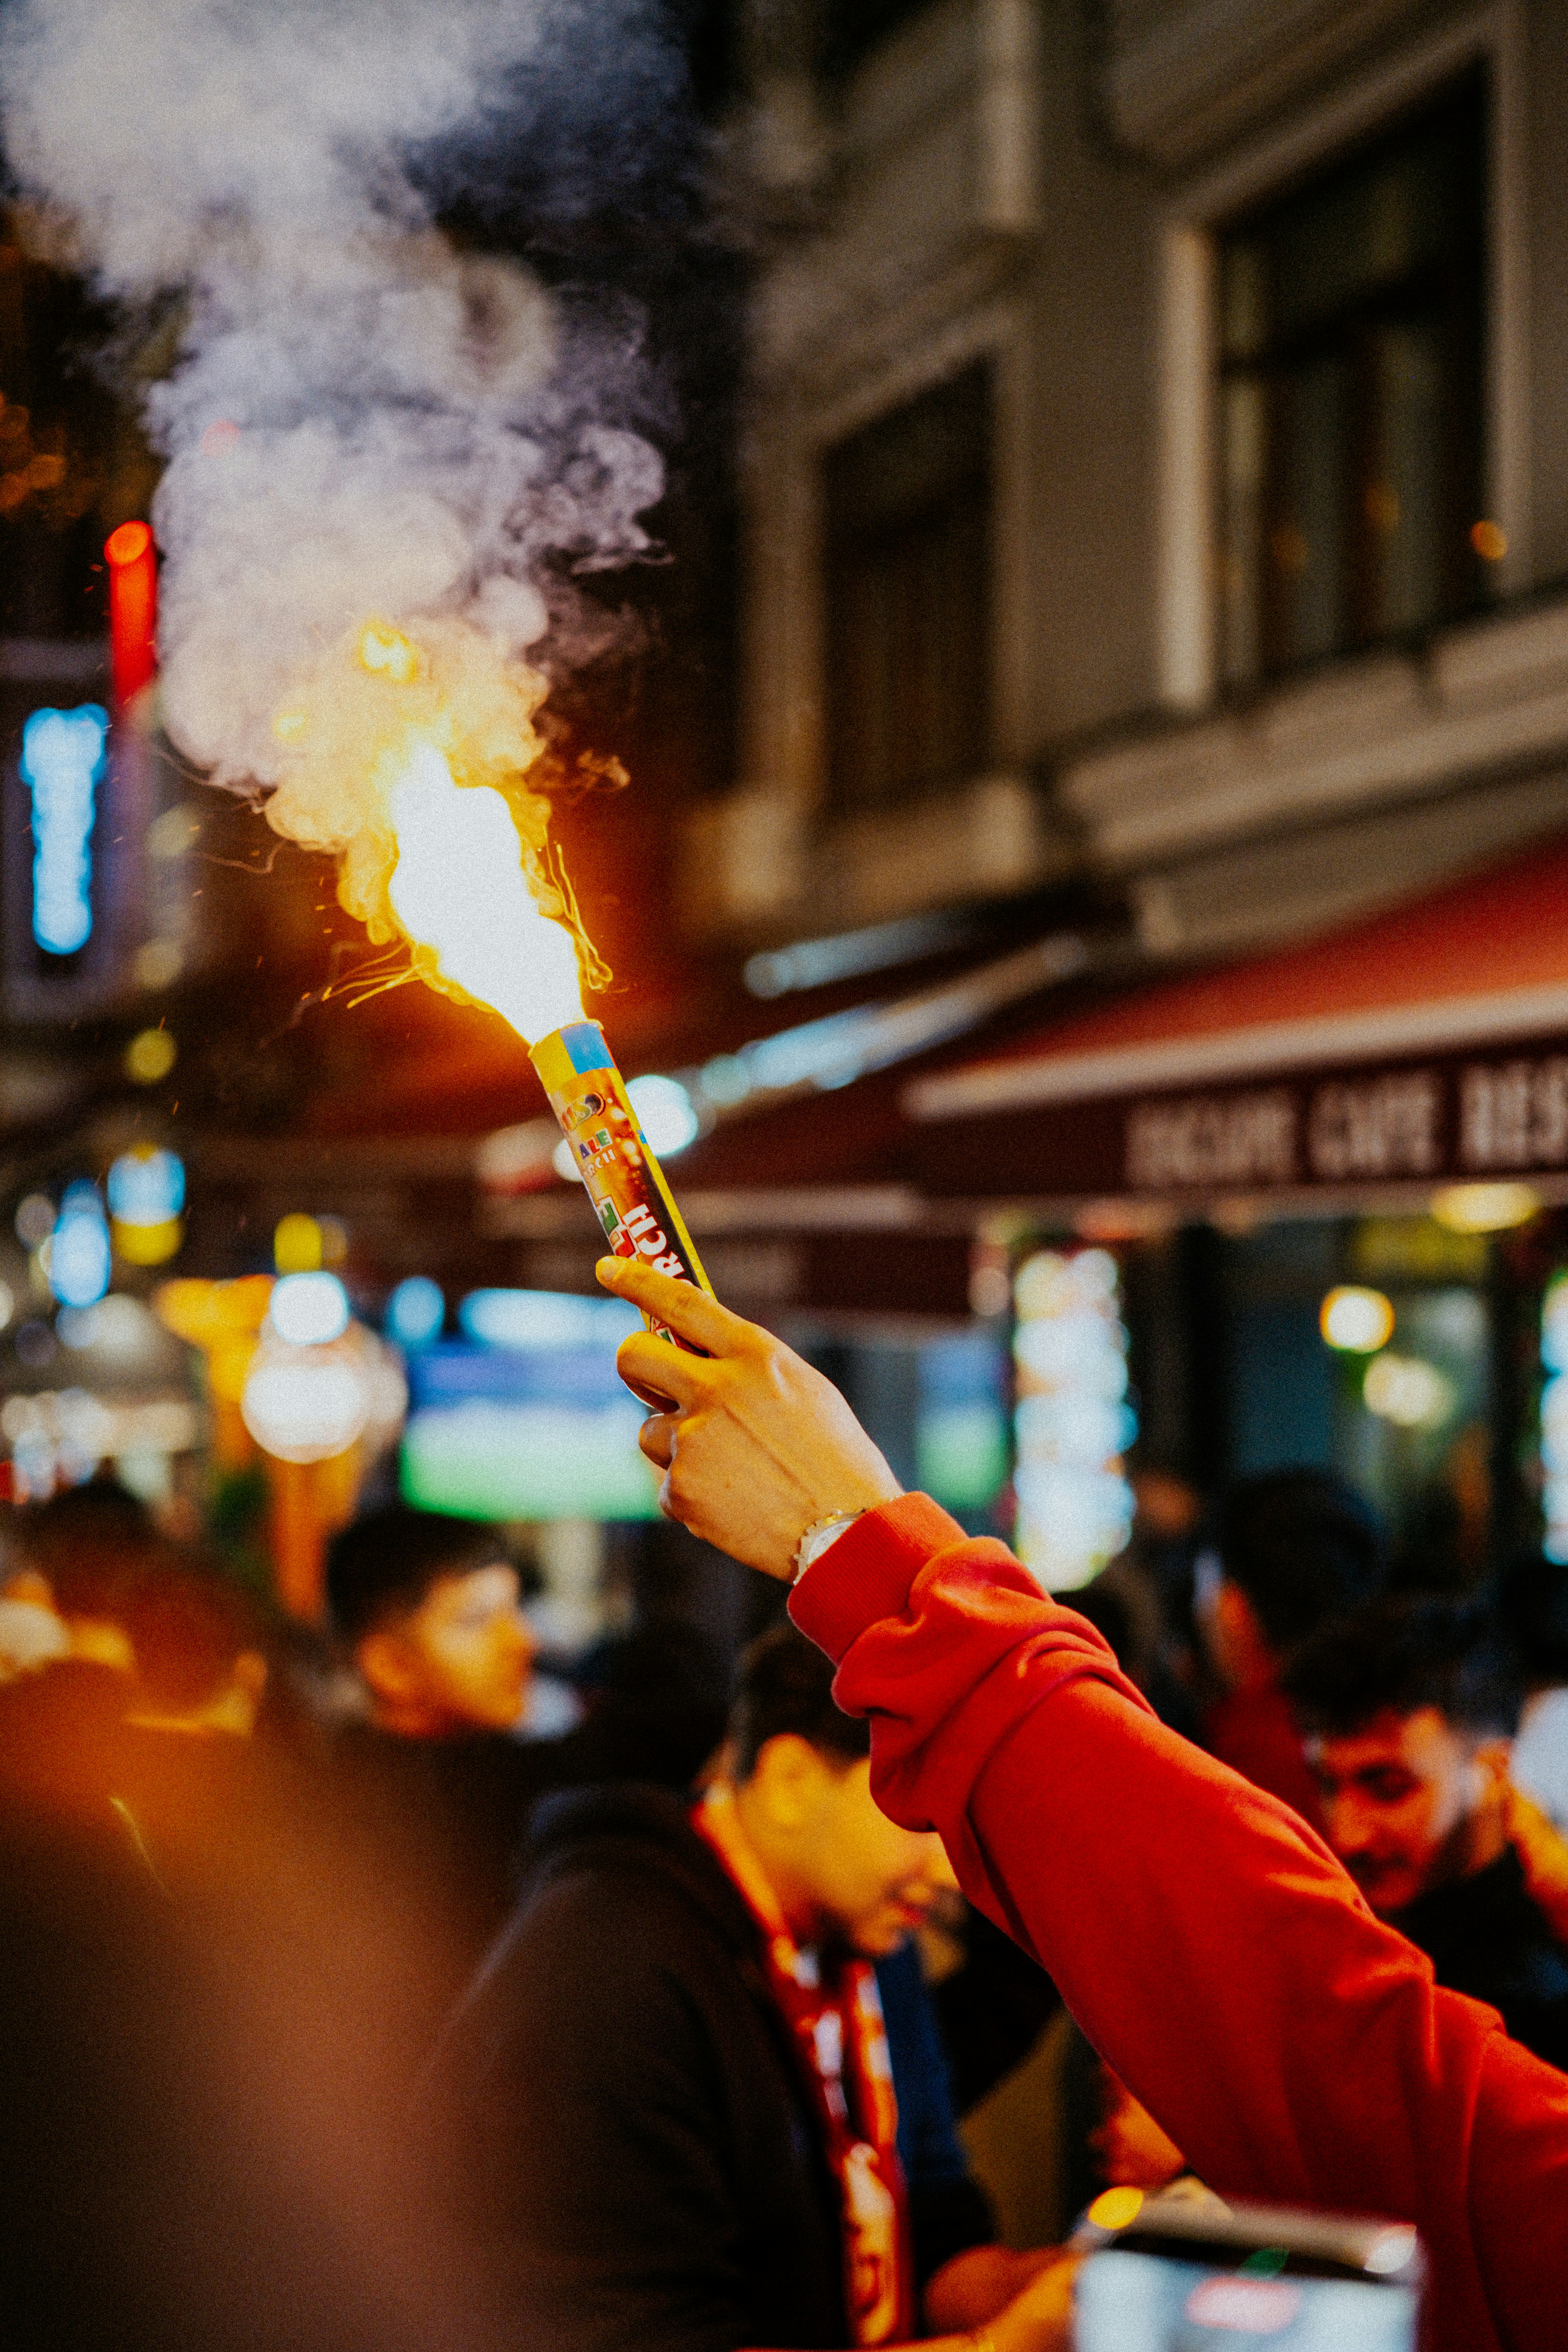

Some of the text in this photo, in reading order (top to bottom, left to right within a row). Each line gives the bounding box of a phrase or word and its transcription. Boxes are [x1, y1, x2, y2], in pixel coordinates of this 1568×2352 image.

[576, 1127, 613, 1167] ALE
[1311, 1072, 1437, 1177] CAFE
[584, 1149, 616, 1176] RCH
[621, 1203, 694, 1287] RCH
